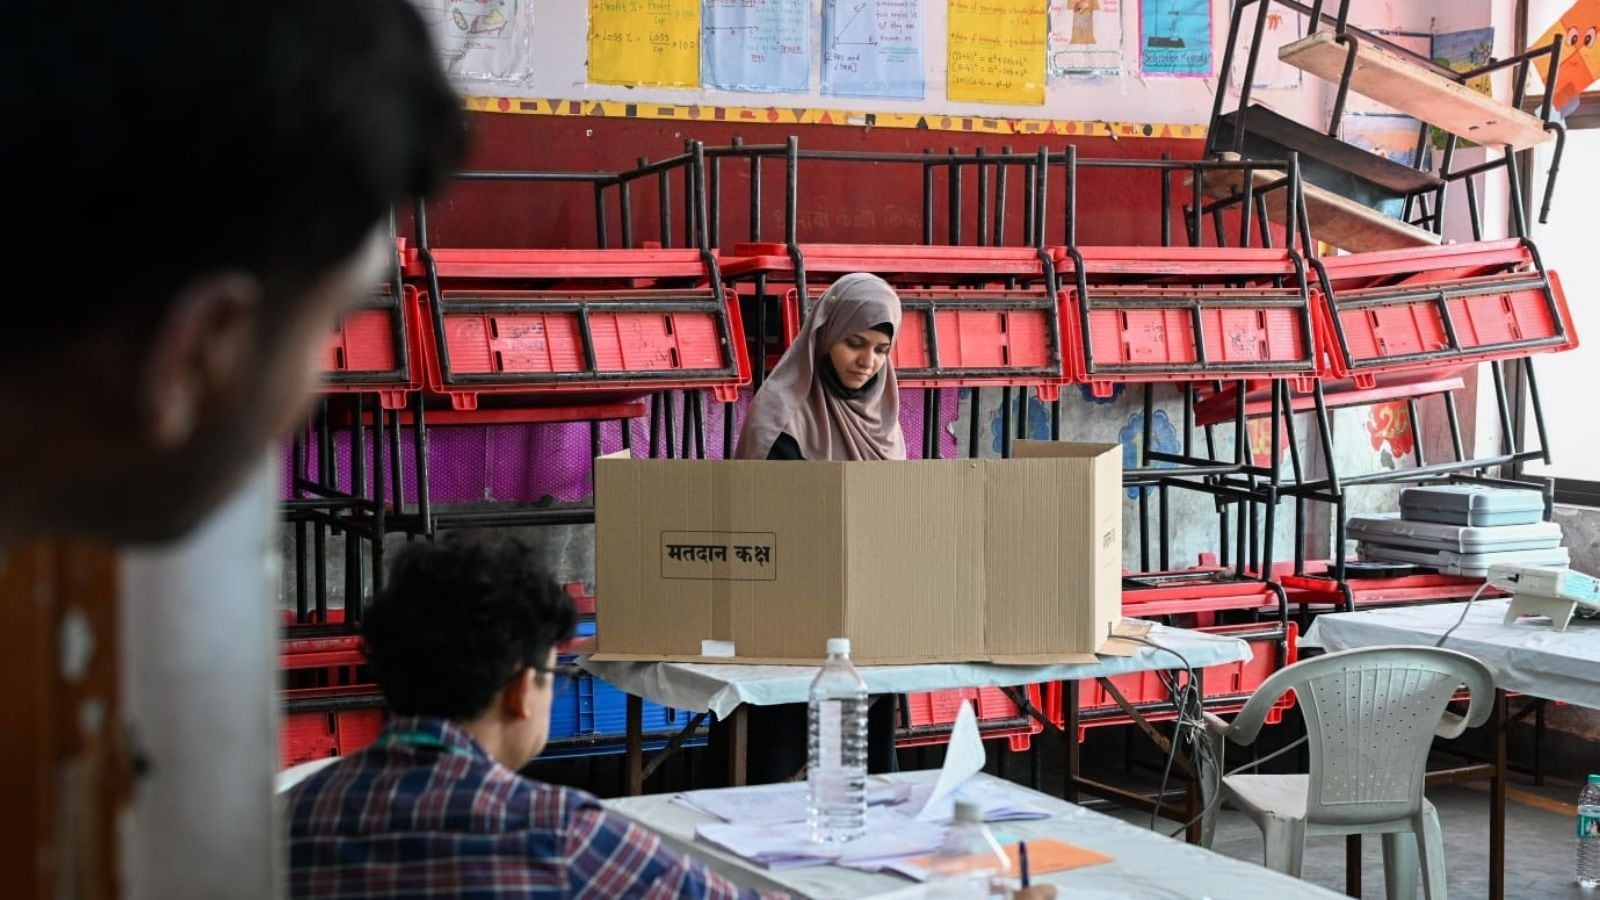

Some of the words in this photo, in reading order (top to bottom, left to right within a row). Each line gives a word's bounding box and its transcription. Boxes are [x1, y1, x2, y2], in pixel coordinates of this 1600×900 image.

[602, 29, 623, 41] Loss
[649, 31, 670, 41] Loss
[666, 545, 728, 563] मतदान
[733, 546, 770, 567] कक्ष
